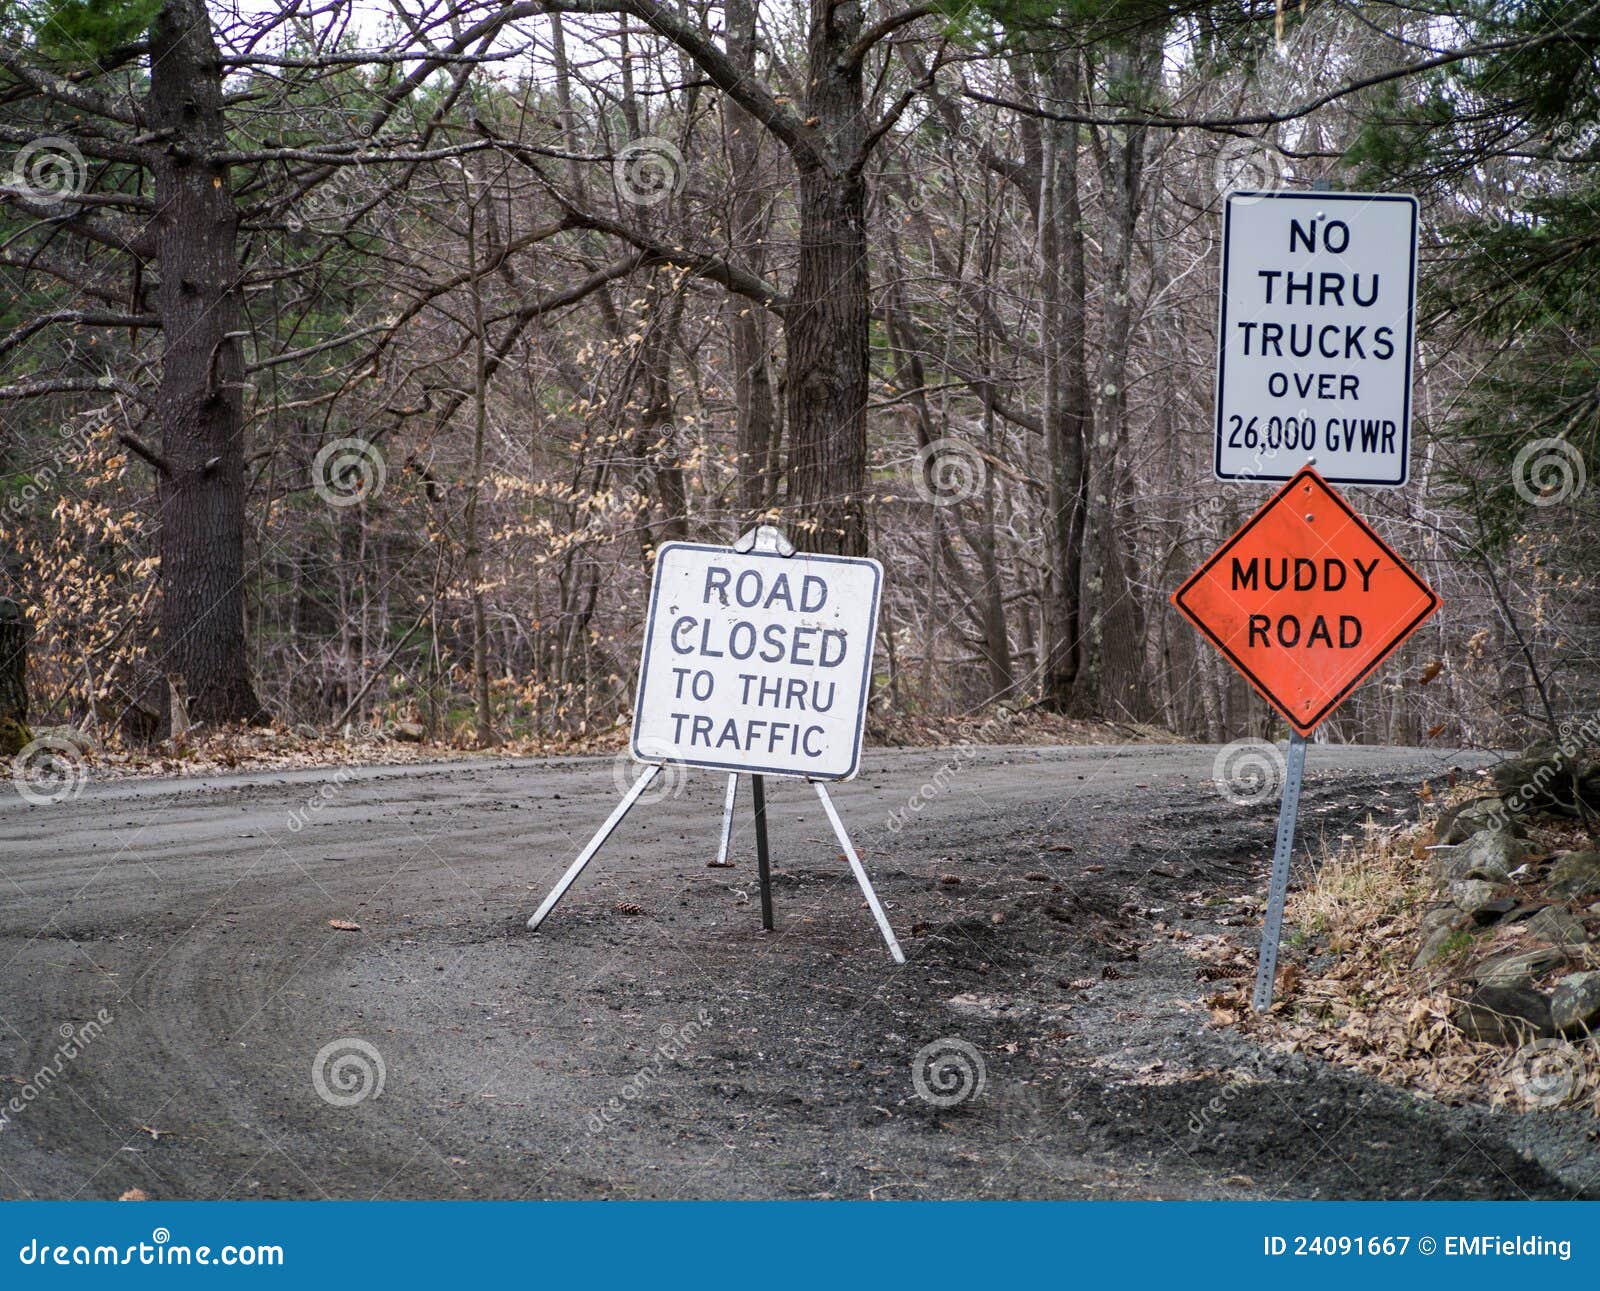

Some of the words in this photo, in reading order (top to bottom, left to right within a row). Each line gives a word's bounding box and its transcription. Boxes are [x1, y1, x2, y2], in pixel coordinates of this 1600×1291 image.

[1289, 218, 1350, 254] NO
[1258, 270, 1379, 307] THRU
[1237, 321, 1395, 360] TRUCKS
[1268, 372, 1360, 401] OVER
[1228, 414, 1317, 455] 26,000
[1325, 418, 1396, 454] GVWR
[703, 566, 828, 613] ROAD
[1231, 557, 1380, 592] MUDDY
[670, 615, 848, 668] CLOSED
[1248, 614, 1363, 649] ROAD
[672, 667, 715, 701] TO
[738, 674, 836, 713] THRU
[671, 713, 825, 758] TRAFFIC
